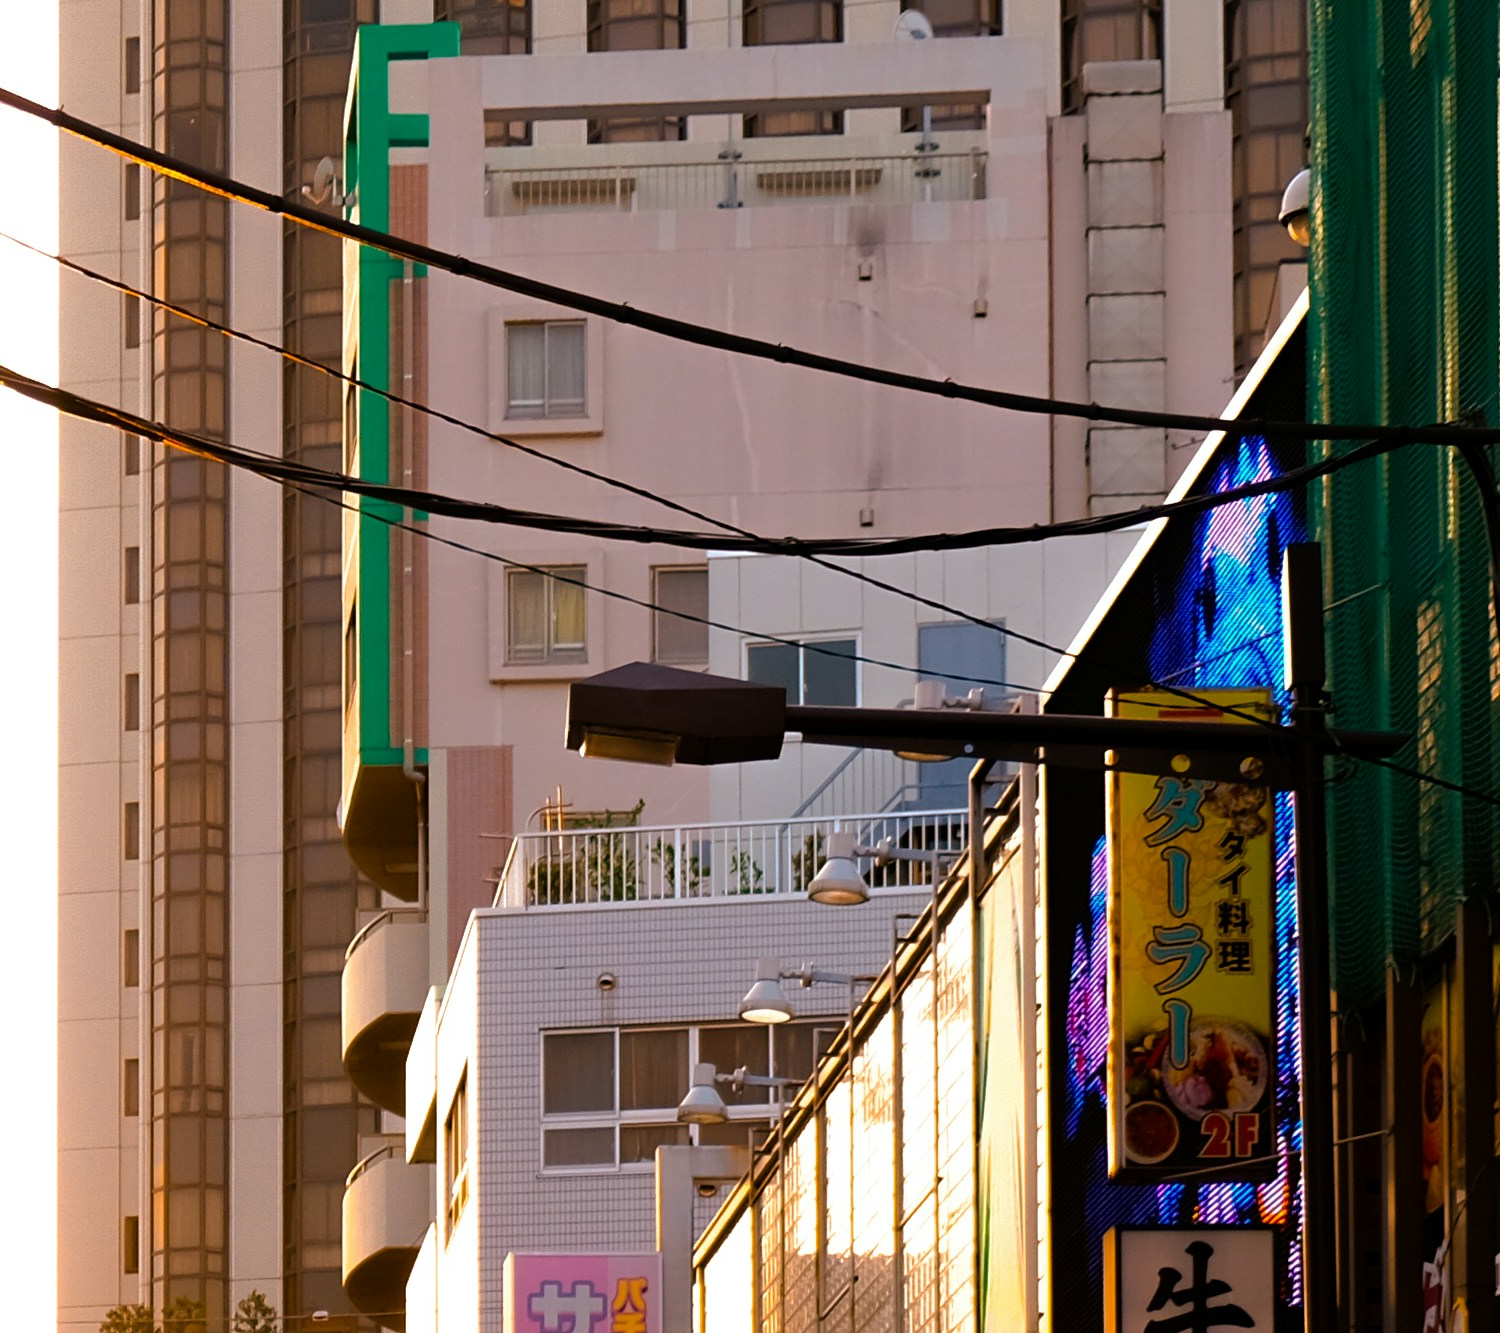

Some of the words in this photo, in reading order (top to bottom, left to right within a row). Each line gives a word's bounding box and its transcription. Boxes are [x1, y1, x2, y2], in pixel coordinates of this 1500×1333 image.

[1215, 830, 1253, 975] タイ料理
[1199, 1111, 1261, 1158] 2F
